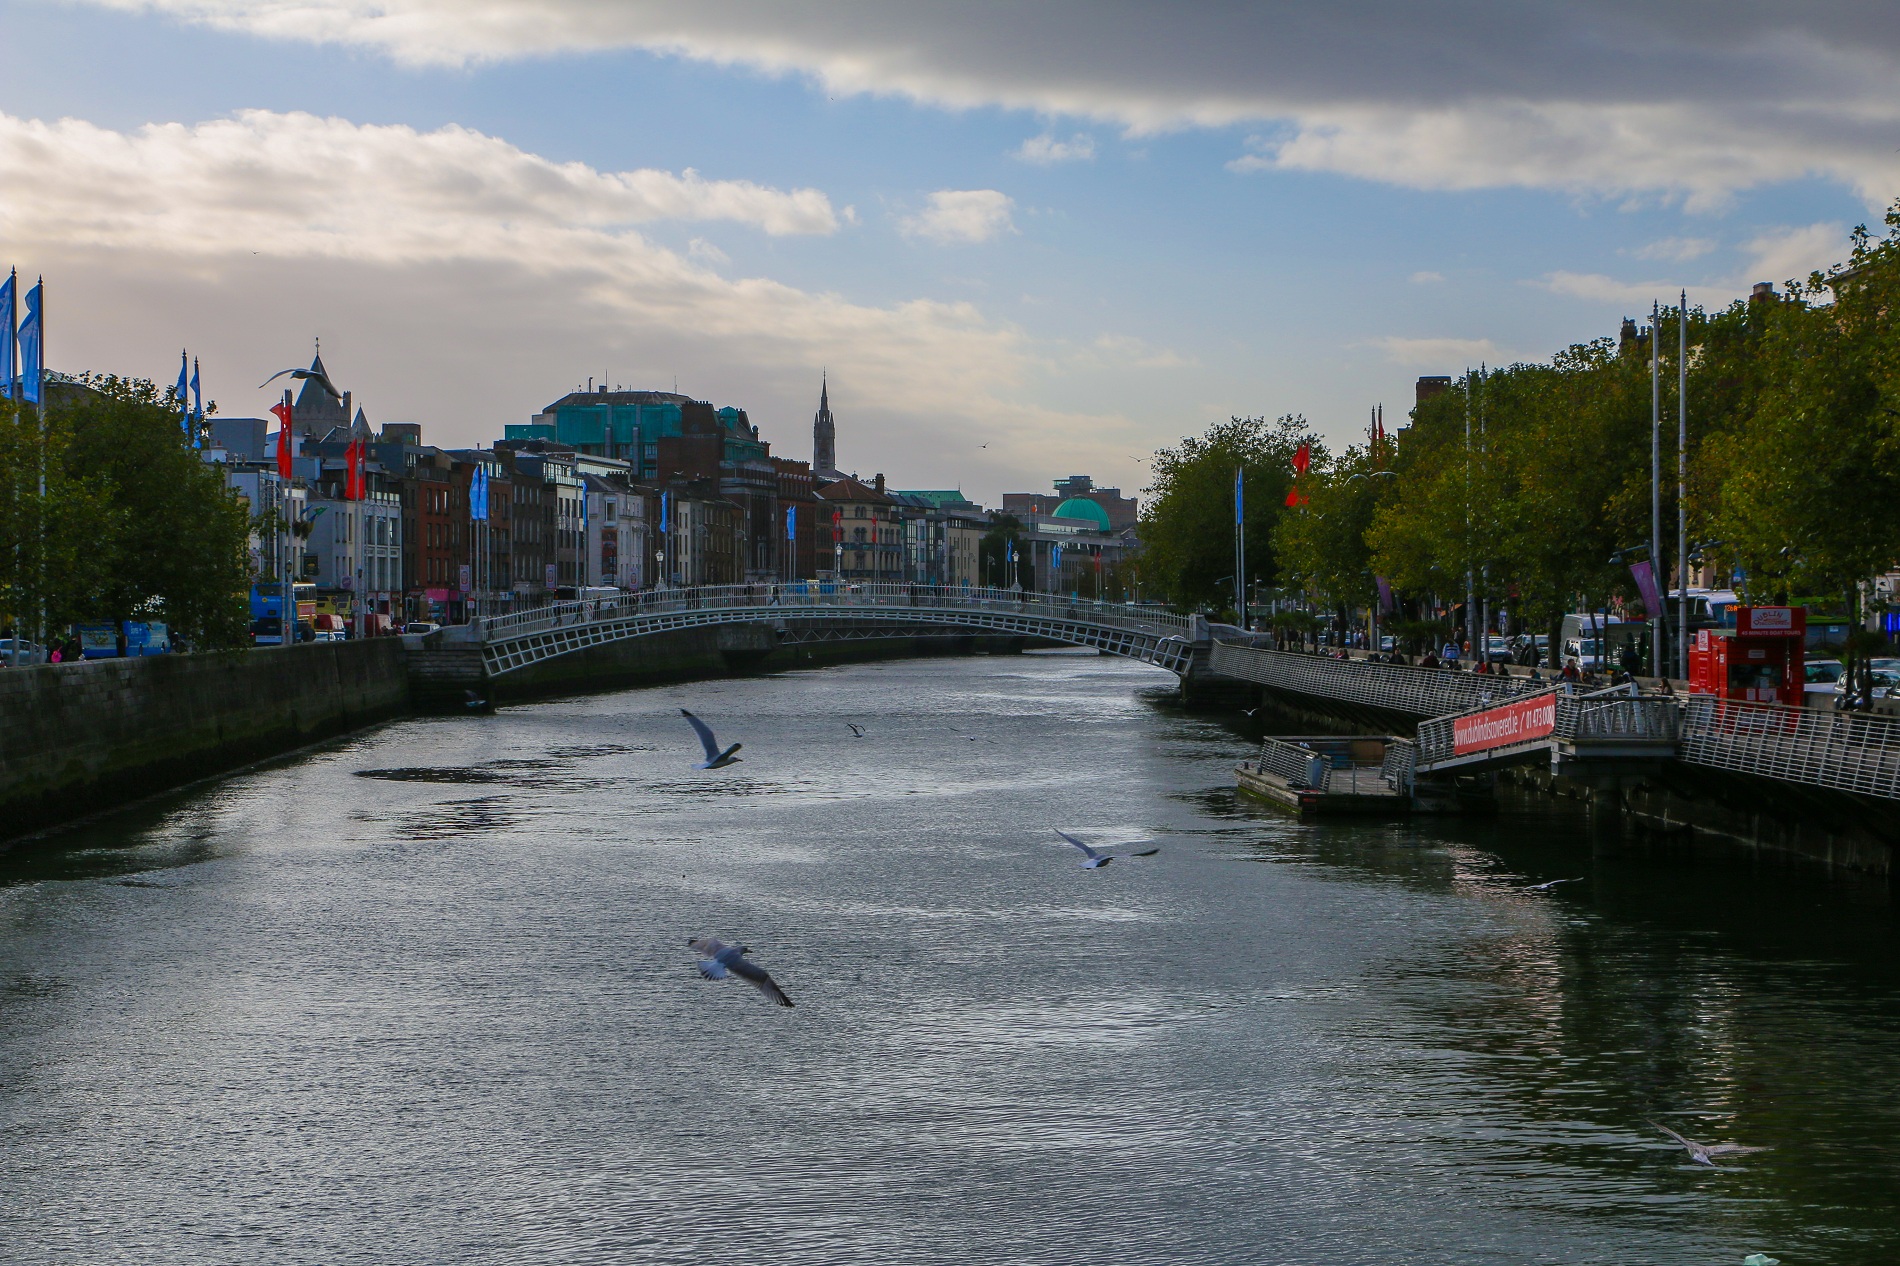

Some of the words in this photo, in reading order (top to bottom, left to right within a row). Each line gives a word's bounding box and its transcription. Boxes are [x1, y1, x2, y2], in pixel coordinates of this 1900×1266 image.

[1753, 611, 1783, 626] DUBLIN
[1455, 710, 1518, 746] www.dublindiscovered.ie
[1526, 710, 1532, 729] 01
[1532, 707, 1542, 728] 473
